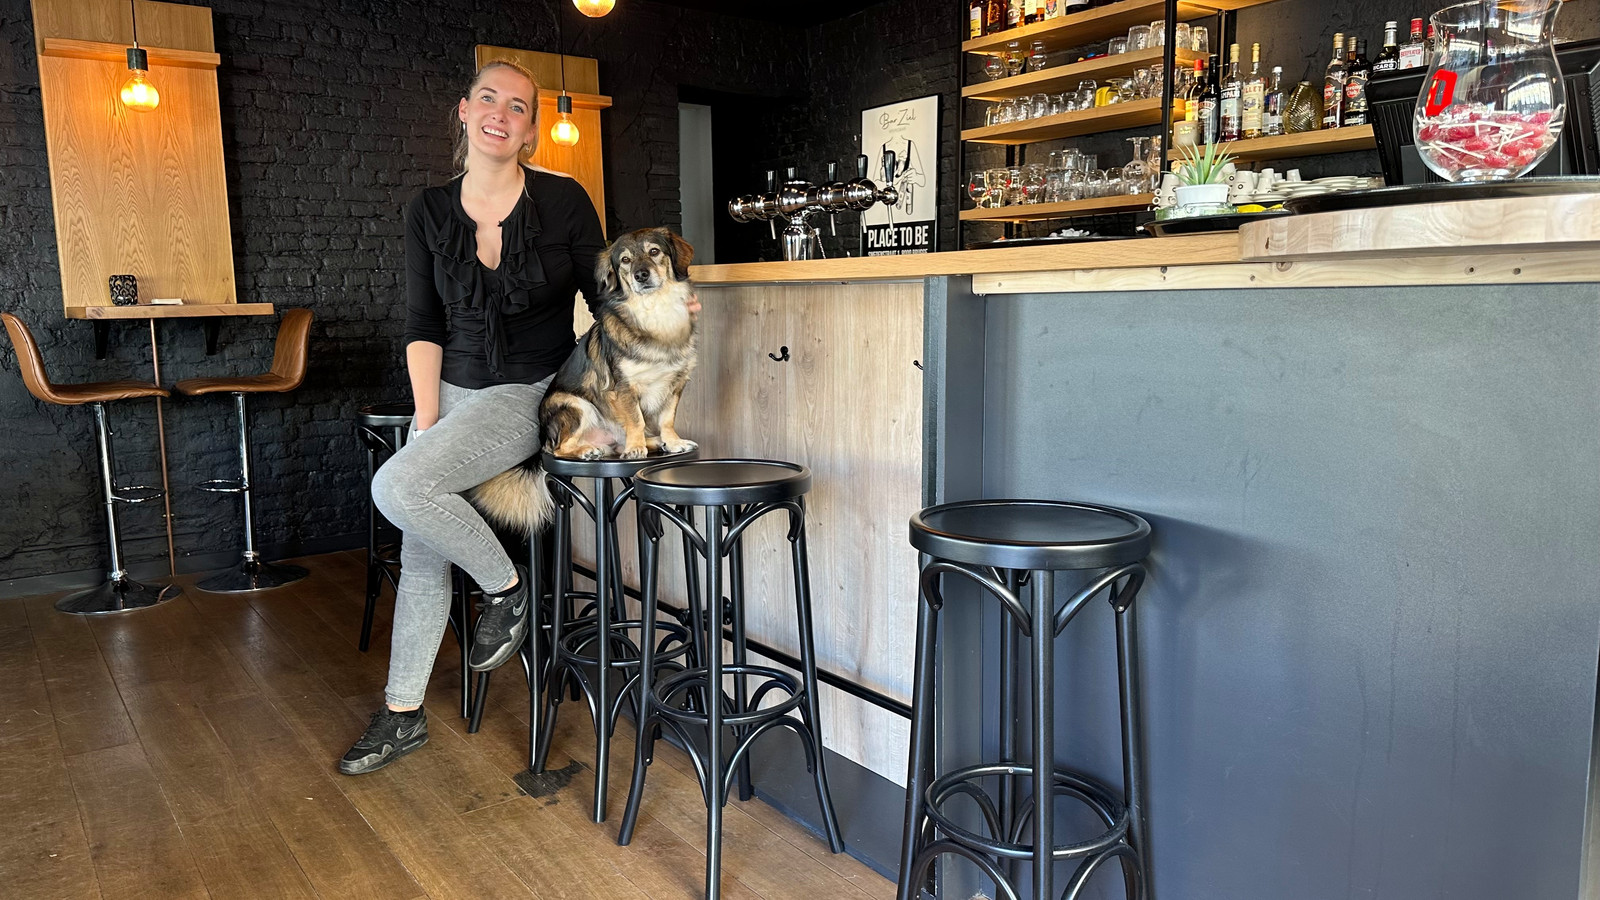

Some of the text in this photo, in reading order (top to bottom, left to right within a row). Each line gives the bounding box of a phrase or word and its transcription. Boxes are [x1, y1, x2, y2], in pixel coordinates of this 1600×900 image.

[879, 108, 916, 130] Bar Ziel
[868, 225, 929, 248] PLACE TO BE
